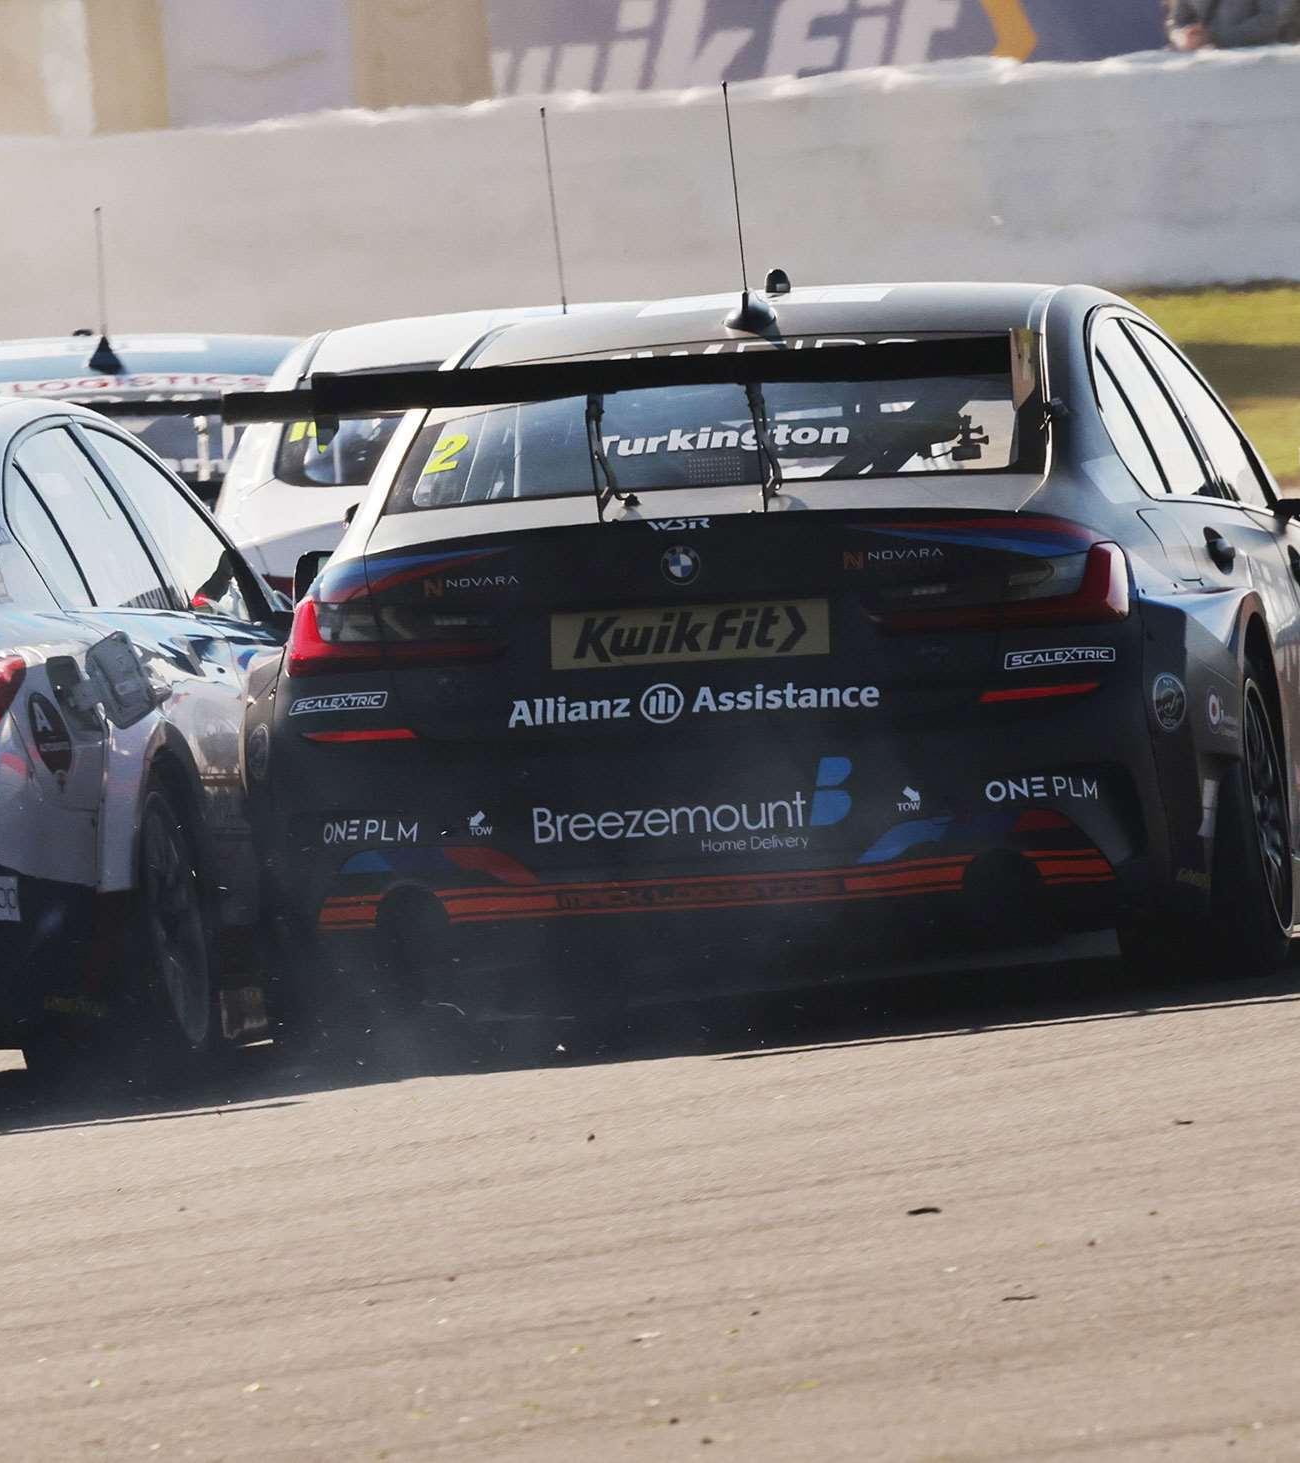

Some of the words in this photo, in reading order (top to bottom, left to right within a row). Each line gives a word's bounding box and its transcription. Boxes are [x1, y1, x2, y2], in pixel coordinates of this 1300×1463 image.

[493, 0, 958, 95] wikFit
[11, 374, 267, 394] LOGISTICS
[423, 432, 470, 476] 2
[646, 517, 710, 531] WSR
[867, 547, 944, 561] NOVARA
[445, 575, 520, 588] NOVARA
[1010, 647, 1110, 666] SCALEXTRIC
[294, 693, 382, 712] SCALEXTRIC
[507, 696, 631, 728] Allianz
[691, 682, 881, 713] Assistance
[896, 801, 922, 812] TOW
[532, 791, 807, 844] Breezemount
[468, 825, 494, 837] TOW
[701, 837, 747, 853] Home
[750, 834, 810, 851] Delivery
